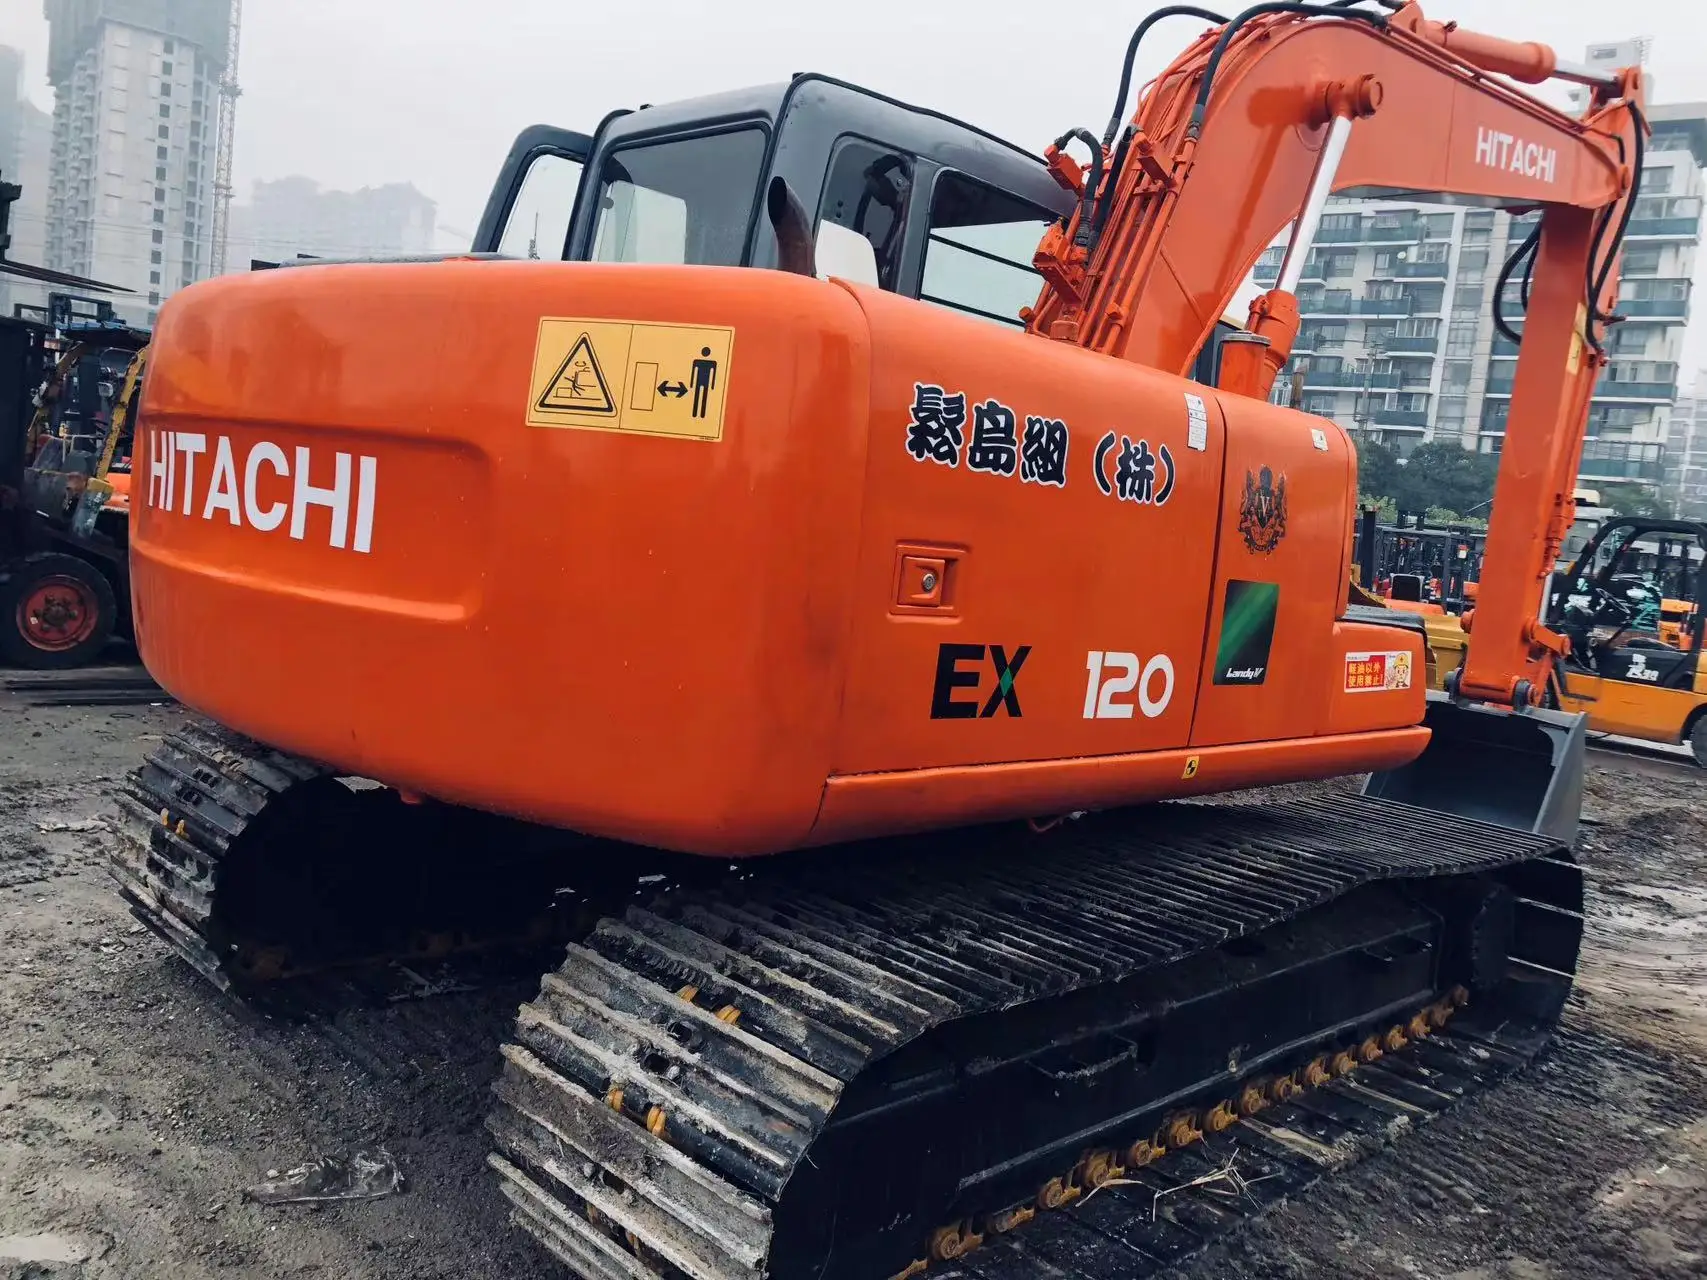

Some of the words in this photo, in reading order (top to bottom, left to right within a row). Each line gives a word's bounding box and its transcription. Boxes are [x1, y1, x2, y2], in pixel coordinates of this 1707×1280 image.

[1475, 126, 1556, 183] HITACHI
[148, 430, 377, 554] HITACHI
[930, 643, 1032, 720] EX
[1082, 650, 1175, 719] 120
